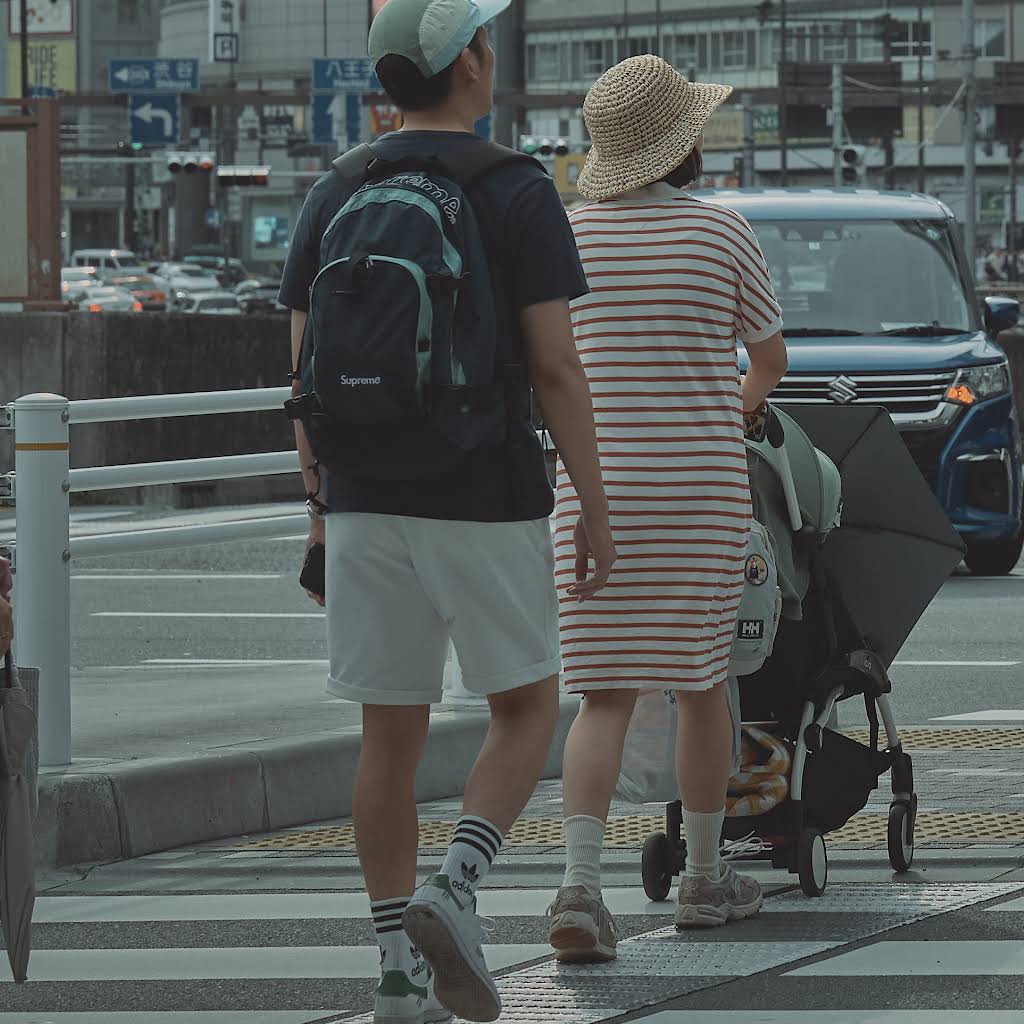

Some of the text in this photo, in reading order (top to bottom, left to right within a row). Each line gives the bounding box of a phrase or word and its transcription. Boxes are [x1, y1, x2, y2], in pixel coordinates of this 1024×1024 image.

[154, 61, 193, 79] 渋谷
[340, 374, 382, 388] Supreme
[742, 622, 761, 635] HH
